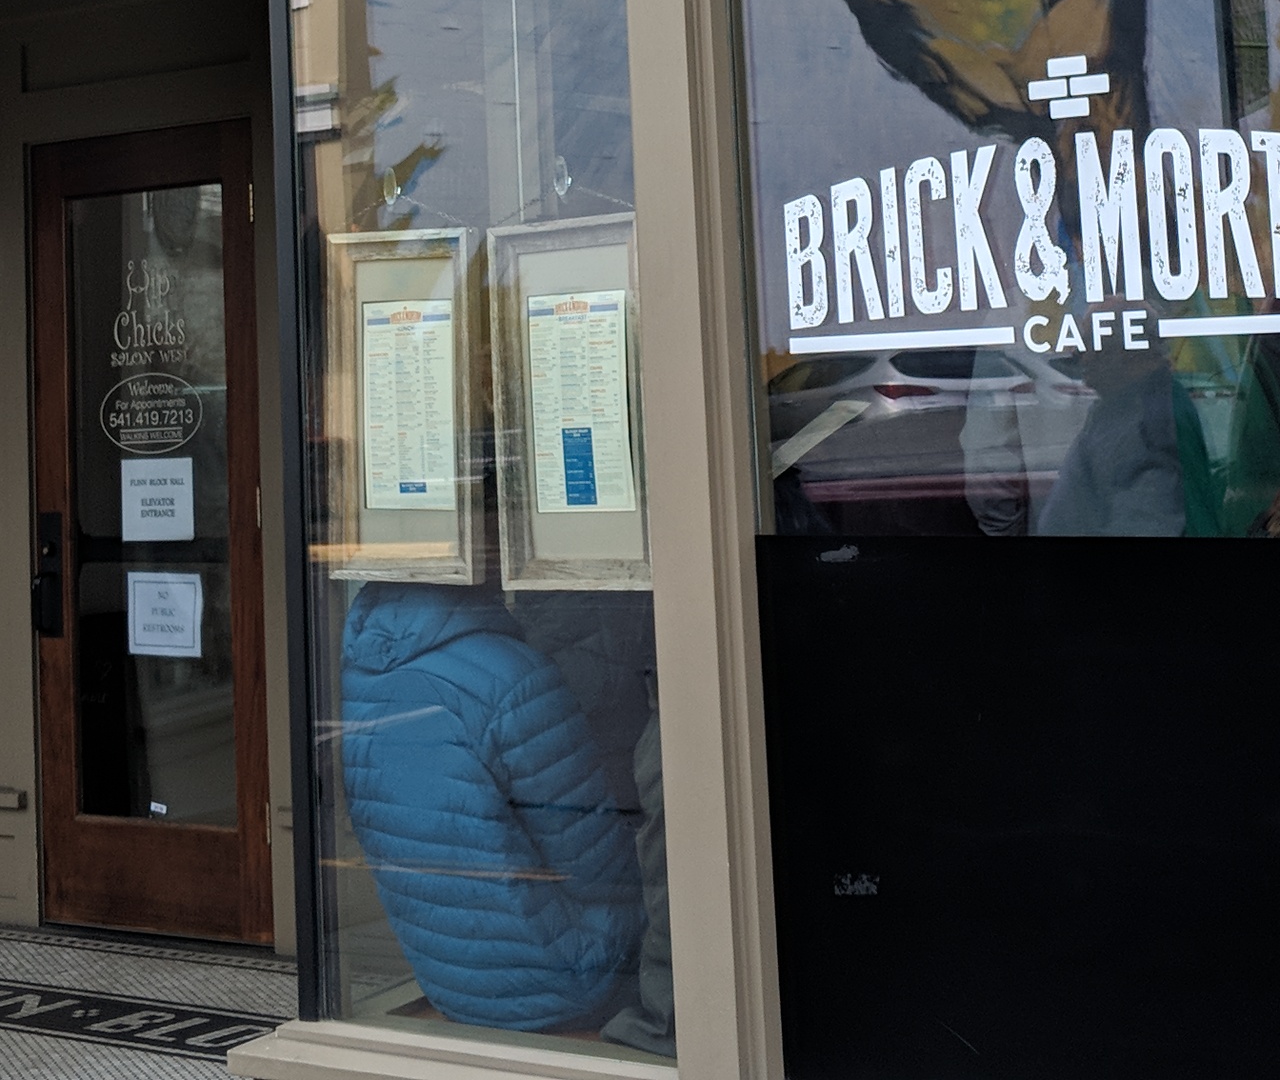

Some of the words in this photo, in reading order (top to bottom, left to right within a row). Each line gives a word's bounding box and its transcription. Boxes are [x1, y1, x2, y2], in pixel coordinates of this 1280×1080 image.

[783, 143, 1009, 332] BRICK
[1015, 137, 1070, 306] &
[126, 259, 170, 311] Hip
[113, 310, 186, 350] Chicks
[1024, 310, 1150, 354] CAFE
[109, 408, 194, 428] 541.419.7213
[140, 508, 176, 518] ENTRANCE
[141, 497, 176, 507] ELEVATOR
[143, 623, 186, 633] RESTROOMS
[83, 1010, 273, 1048] BLO
